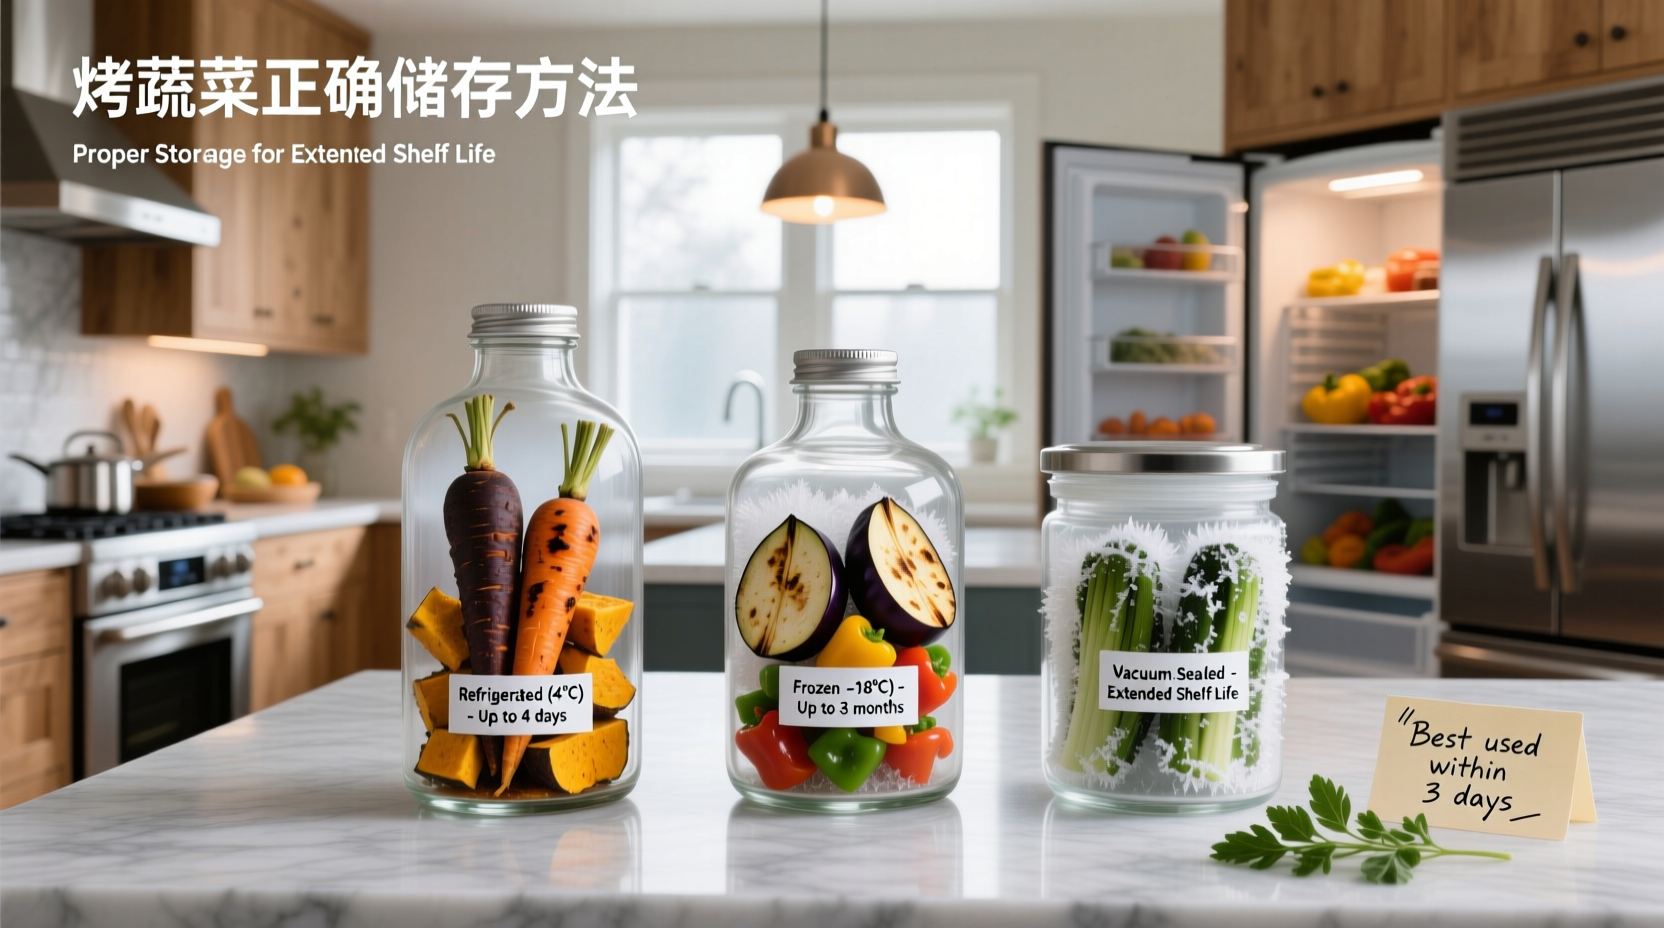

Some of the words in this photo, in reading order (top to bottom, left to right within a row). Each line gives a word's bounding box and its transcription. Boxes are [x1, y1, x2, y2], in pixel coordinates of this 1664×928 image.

[793, 679, 840, 695] Frozen
[1107, 684, 1173, 701] Extended
[1176, 685, 1212, 701] Shelf
[1215, 685, 1239, 700] Life
[478, 709, 498, 727] Up
[502, 711, 518, 723] to
[521, 709, 531, 723] 4
[535, 708, 567, 726] days
[797, 700, 817, 719] Up
[821, 702, 836, 715] to
[839, 701, 849, 715] 3
[853, 699, 904, 715] months
[1485, 733, 1542, 757] used
[1430, 755, 1506, 781] within
[1422, 782, 1440, 803] 3
